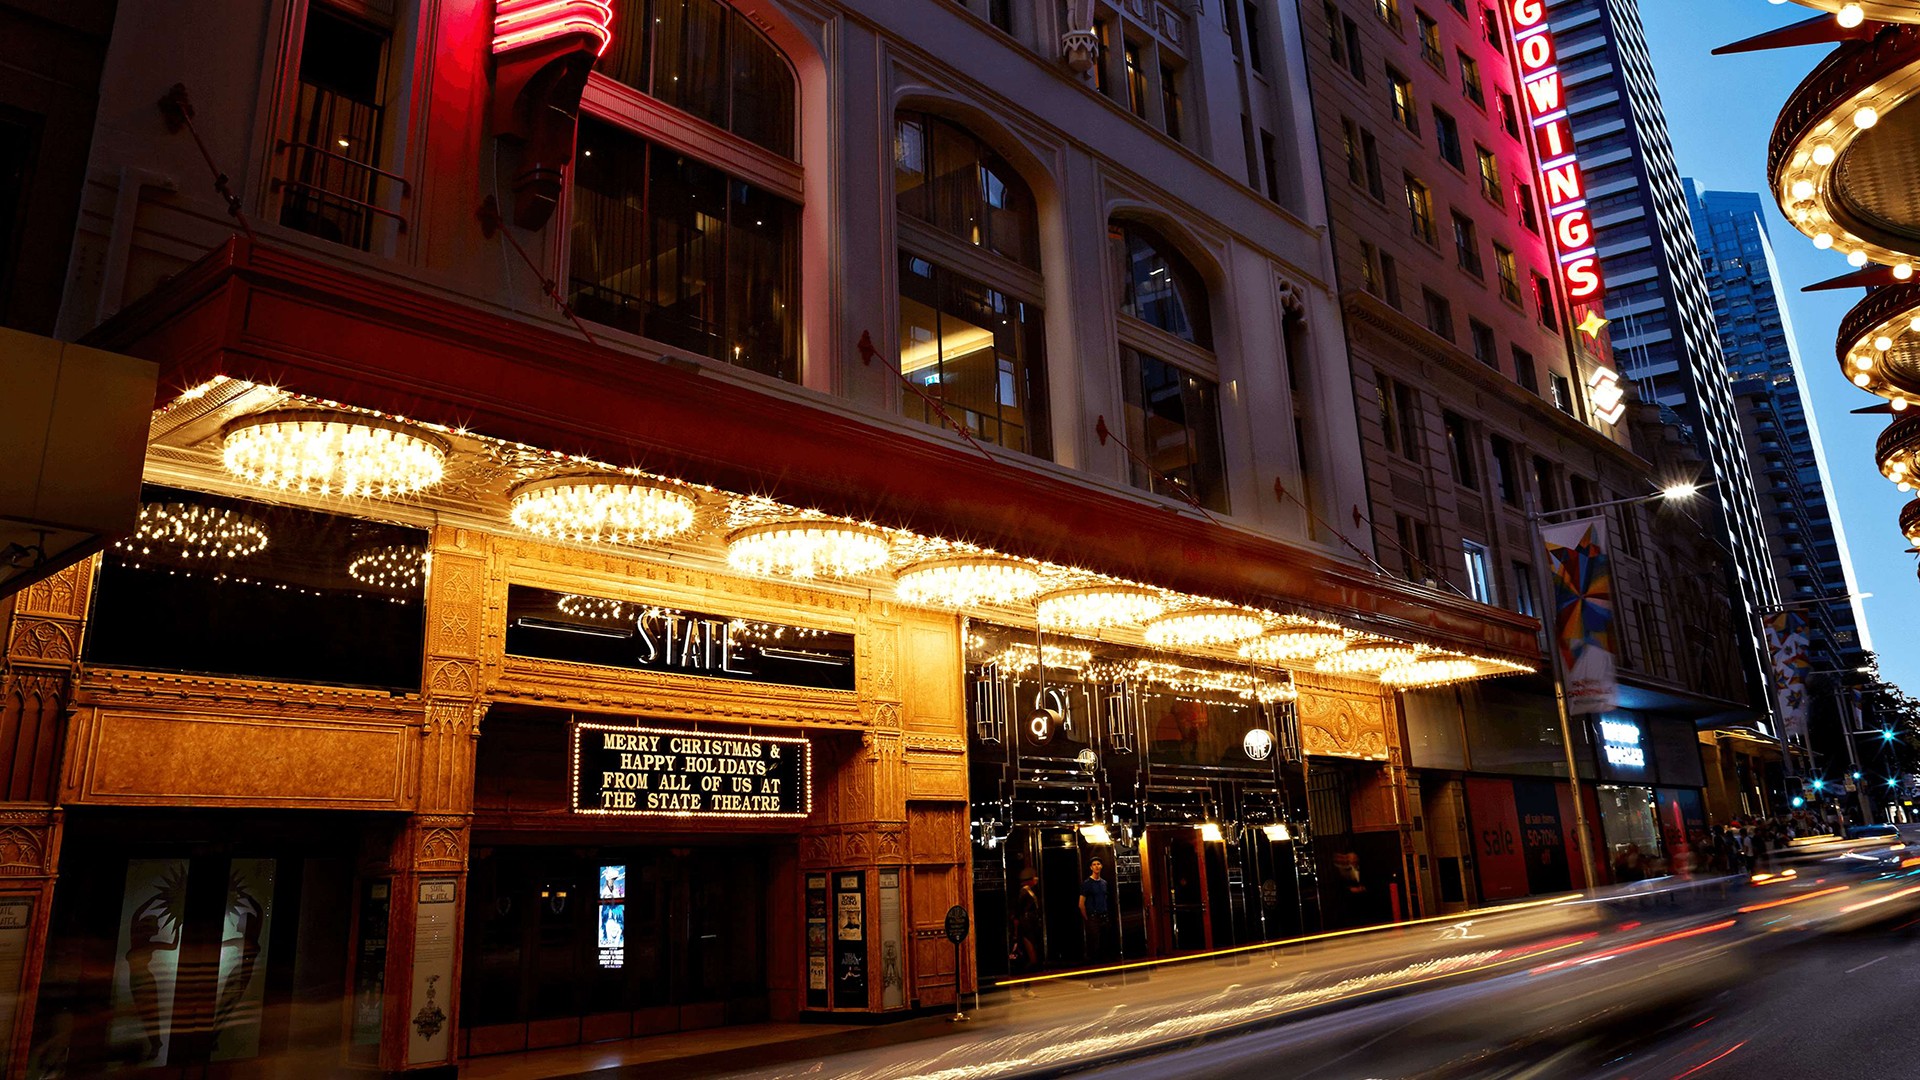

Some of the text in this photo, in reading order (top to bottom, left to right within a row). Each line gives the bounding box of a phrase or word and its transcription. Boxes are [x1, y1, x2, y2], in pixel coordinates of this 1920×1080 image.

[1513, 0, 1598, 297] GOWINGS
[636, 610, 752, 674] STATE
[604, 733, 780, 759] MERRY CHRISTMAS &
[620, 753, 767, 776] HAPPY HOLIDAYS
[602, 771, 780, 794] FROM ALL OF US AT
[602, 791, 780, 812] THE STATE THEATRE
[1483, 823, 1515, 856] sale
[1527, 829, 1559, 847] 50-70%
